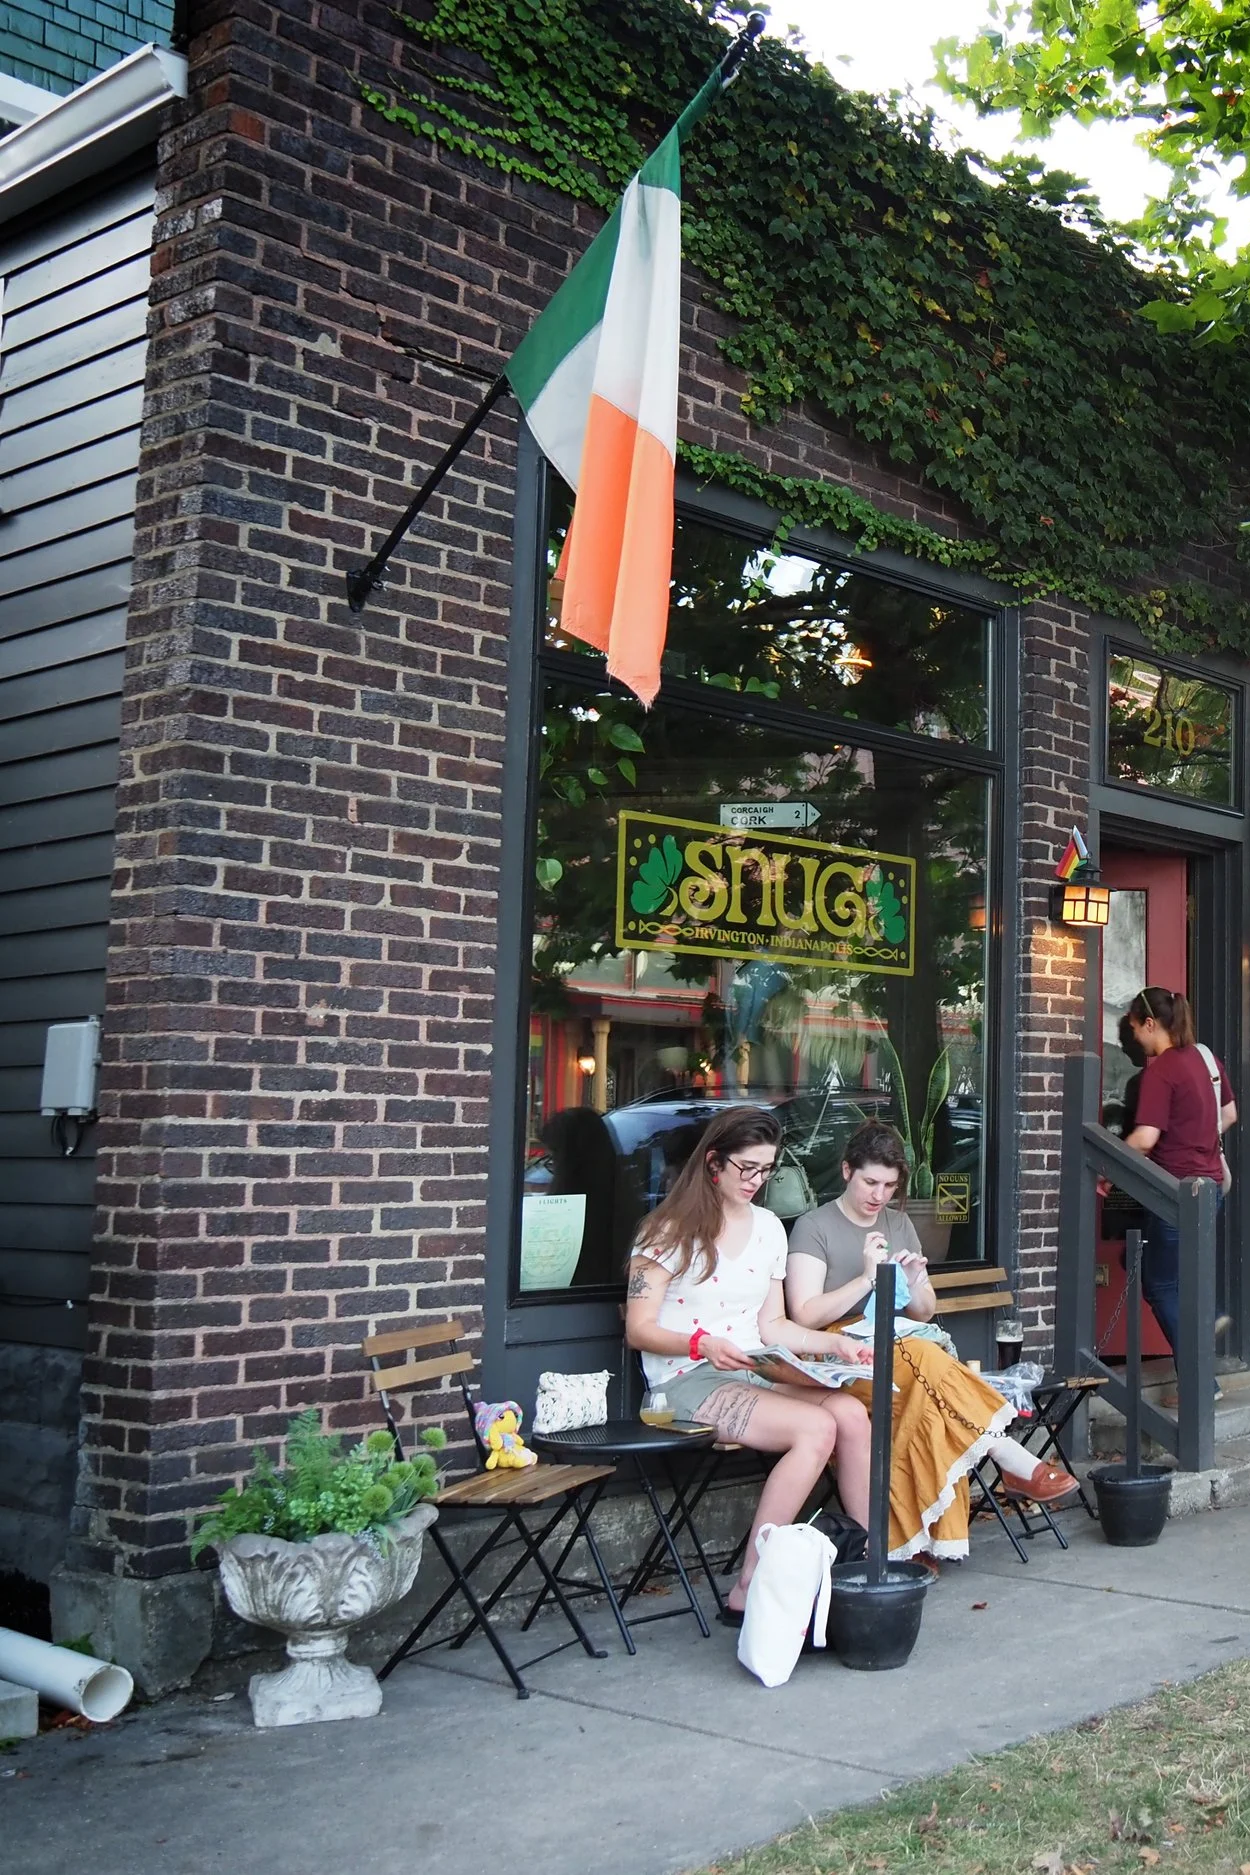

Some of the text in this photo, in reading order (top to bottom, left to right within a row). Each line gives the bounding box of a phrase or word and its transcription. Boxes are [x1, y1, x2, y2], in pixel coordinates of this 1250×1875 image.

[1143, 706, 1195, 756] 210
[731, 806, 774, 814] CORCAIGH
[731, 816, 767, 825] CORK
[794, 810, 801, 819] 2
[694, 927, 853, 956] IRVINGTON INDIANAPOLIS
[939, 1175, 969, 1183] NO GUNS
